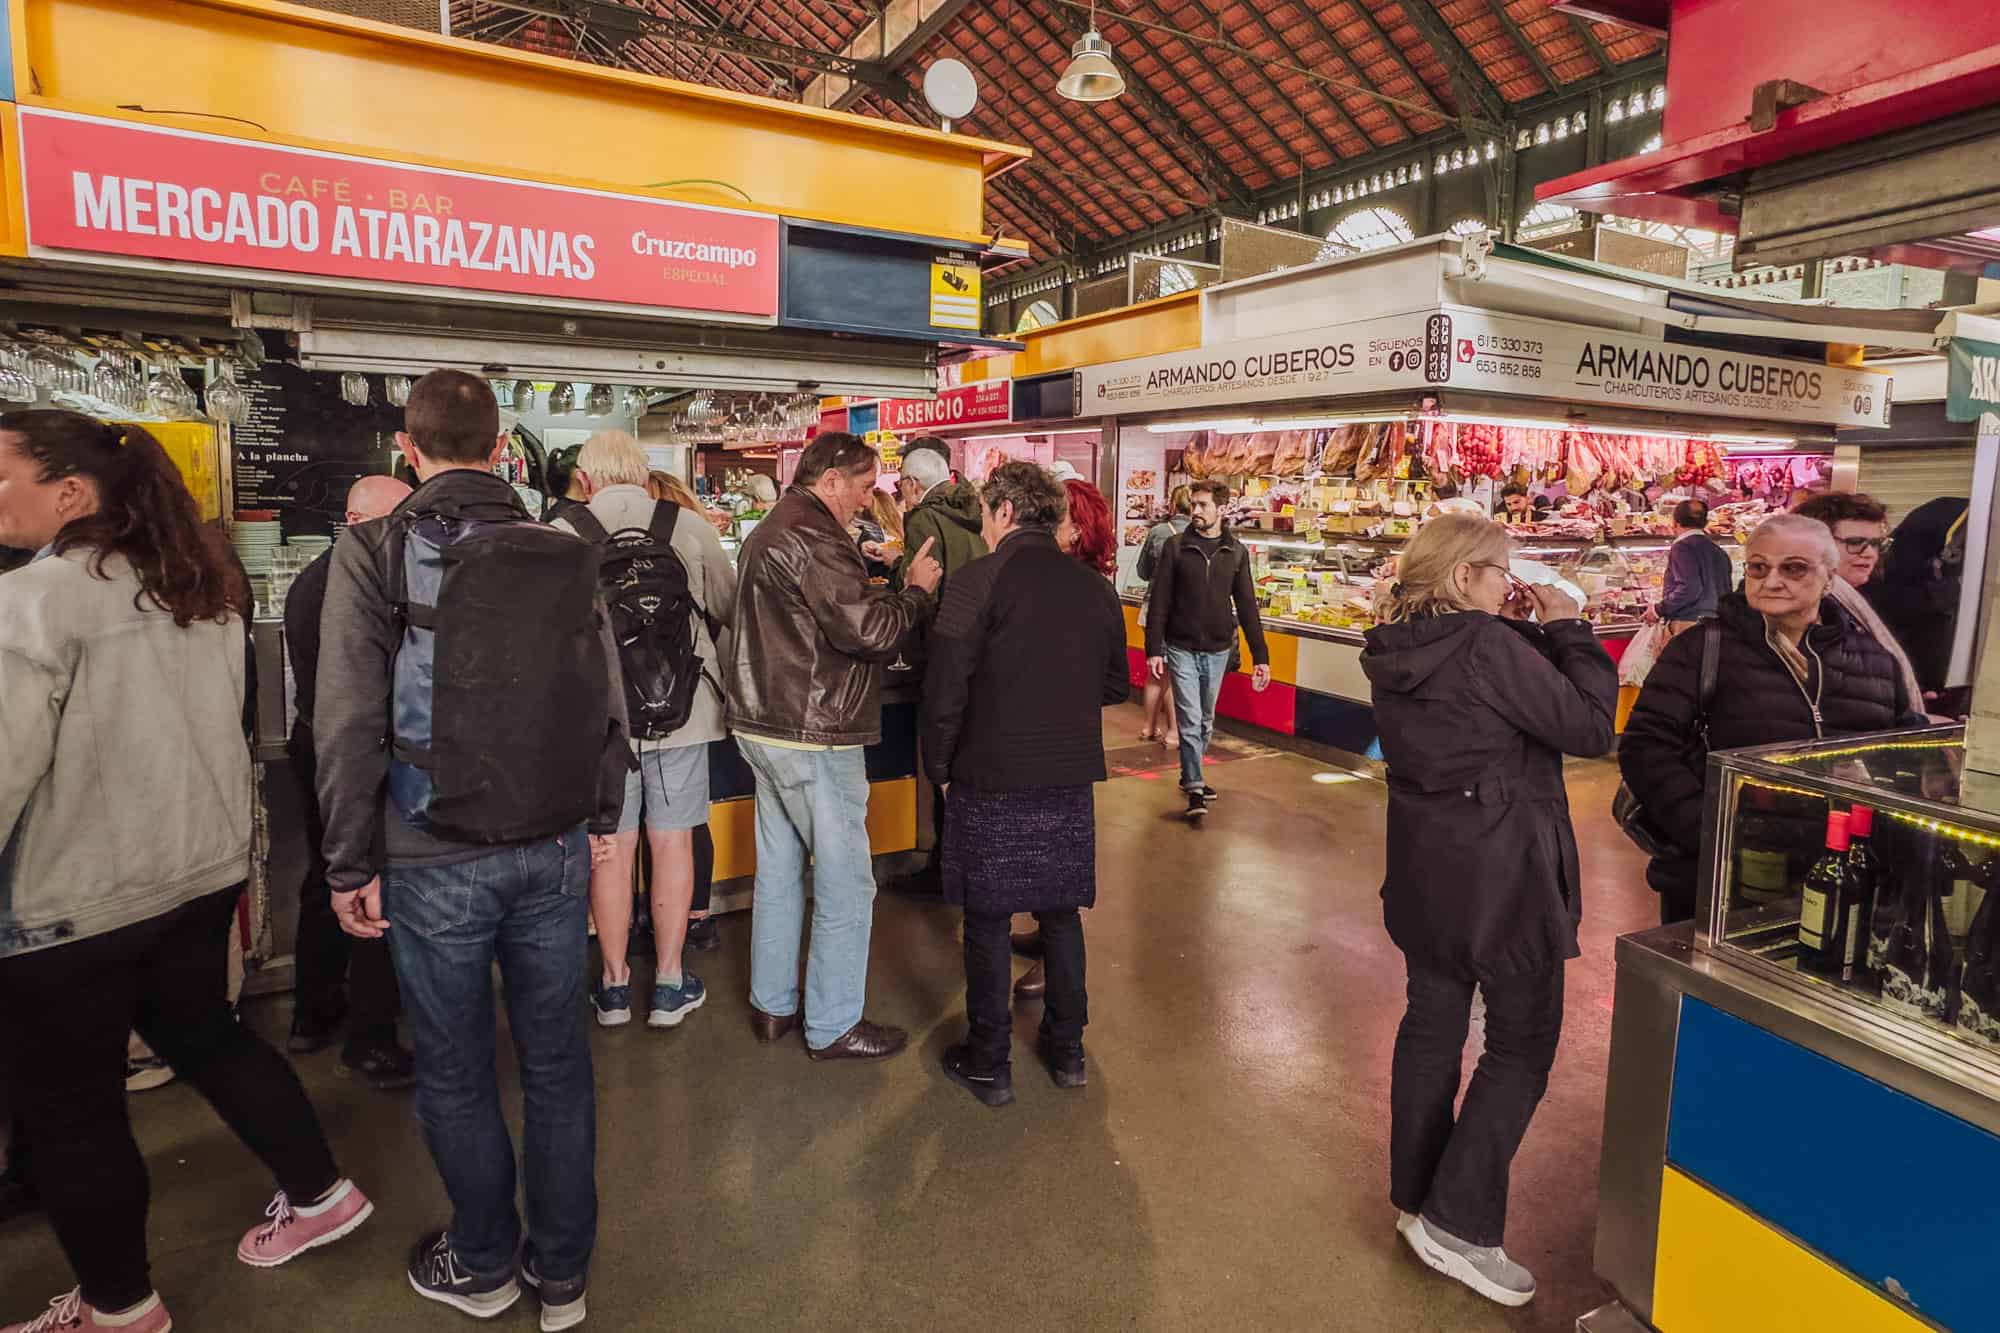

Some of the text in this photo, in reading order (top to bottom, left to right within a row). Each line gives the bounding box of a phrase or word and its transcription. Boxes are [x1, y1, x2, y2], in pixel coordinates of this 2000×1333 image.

[260, 172, 454, 215] CAFÉ BAR
[72, 170, 595, 280] MERCADO ATARAZANAS
[631, 229, 757, 269] Cruzcampo
[1477, 334, 1543, 355] 615 330 373
[1147, 343, 1355, 390] ARMANDO CUBEROS
[1476, 360, 1541, 378] 653 852 858
[1576, 342, 1822, 400] ARMANDO CUBEROS
[1216, 379, 1265, 392] ARTESANOS
[1268, 375, 1297, 387] DESDE
[1302, 371, 1330, 383] 1927
[1604, 381, 1682, 401] CHARCUTEROS
[1685, 389, 1740, 407] ARTESANOS
[897, 396, 964, 425] ASENCIO
[239, 451, 308, 462] A la plancha
